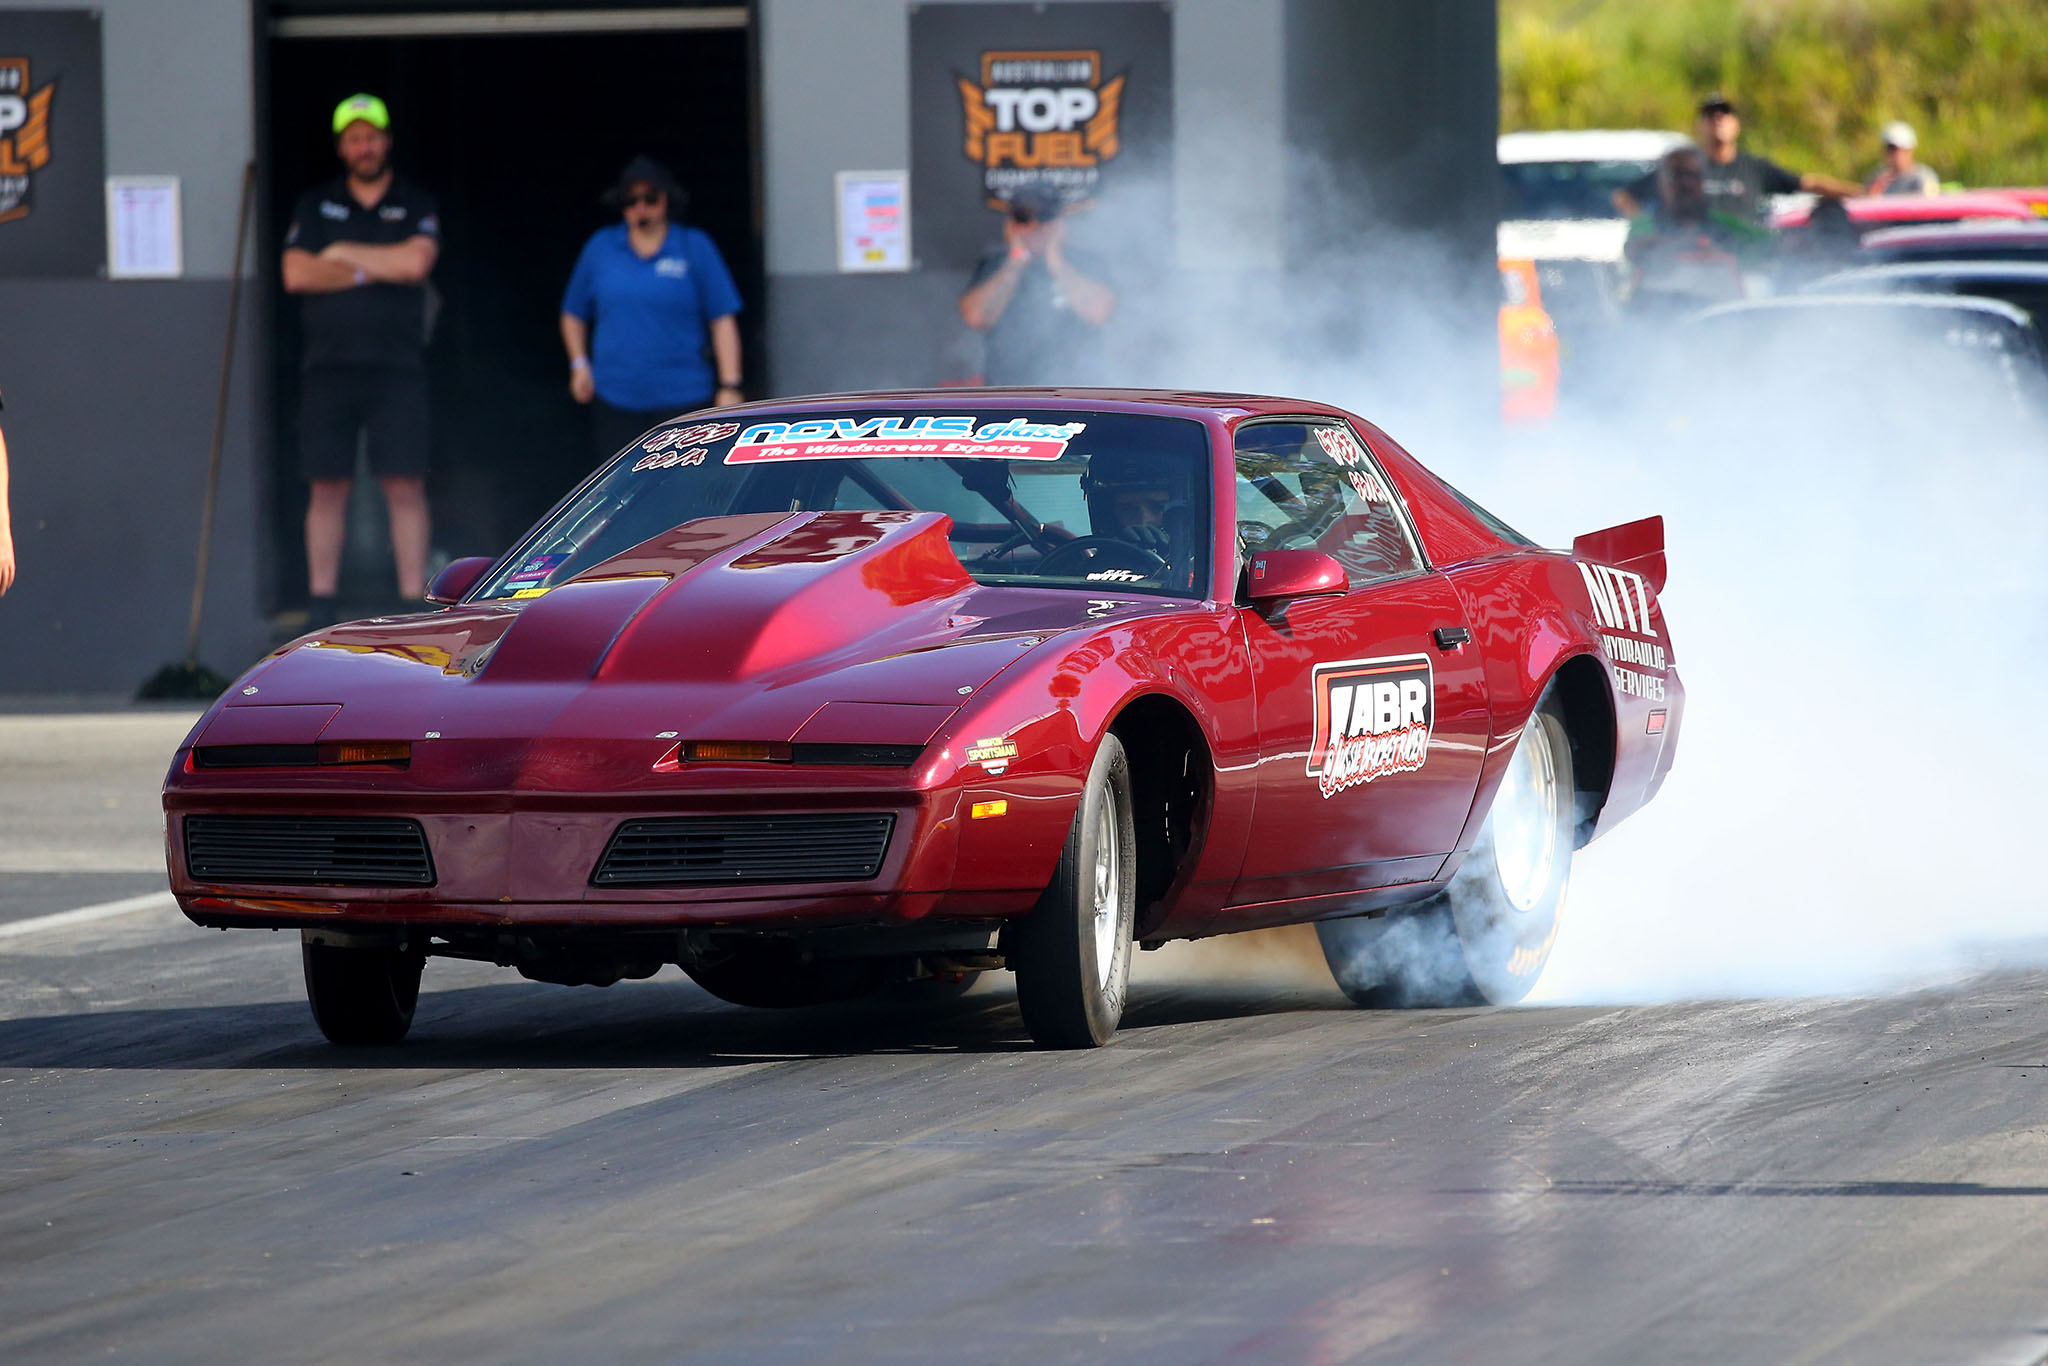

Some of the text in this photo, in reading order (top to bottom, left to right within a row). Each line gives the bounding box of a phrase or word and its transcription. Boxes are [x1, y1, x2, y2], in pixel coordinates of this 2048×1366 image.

[985, 87, 1097, 132] TOP
[986, 132, 1096, 168] FUEL
[974, 419, 1076, 442] glass
[758, 443, 1031, 457] The Windscreen Experts
[1576, 561, 1658, 638] NITZ
[1602, 634, 1666, 671] HYDRAULIC
[1613, 665, 1665, 703] SERVICES
[968, 744, 1017, 762] SPORTSMAN
